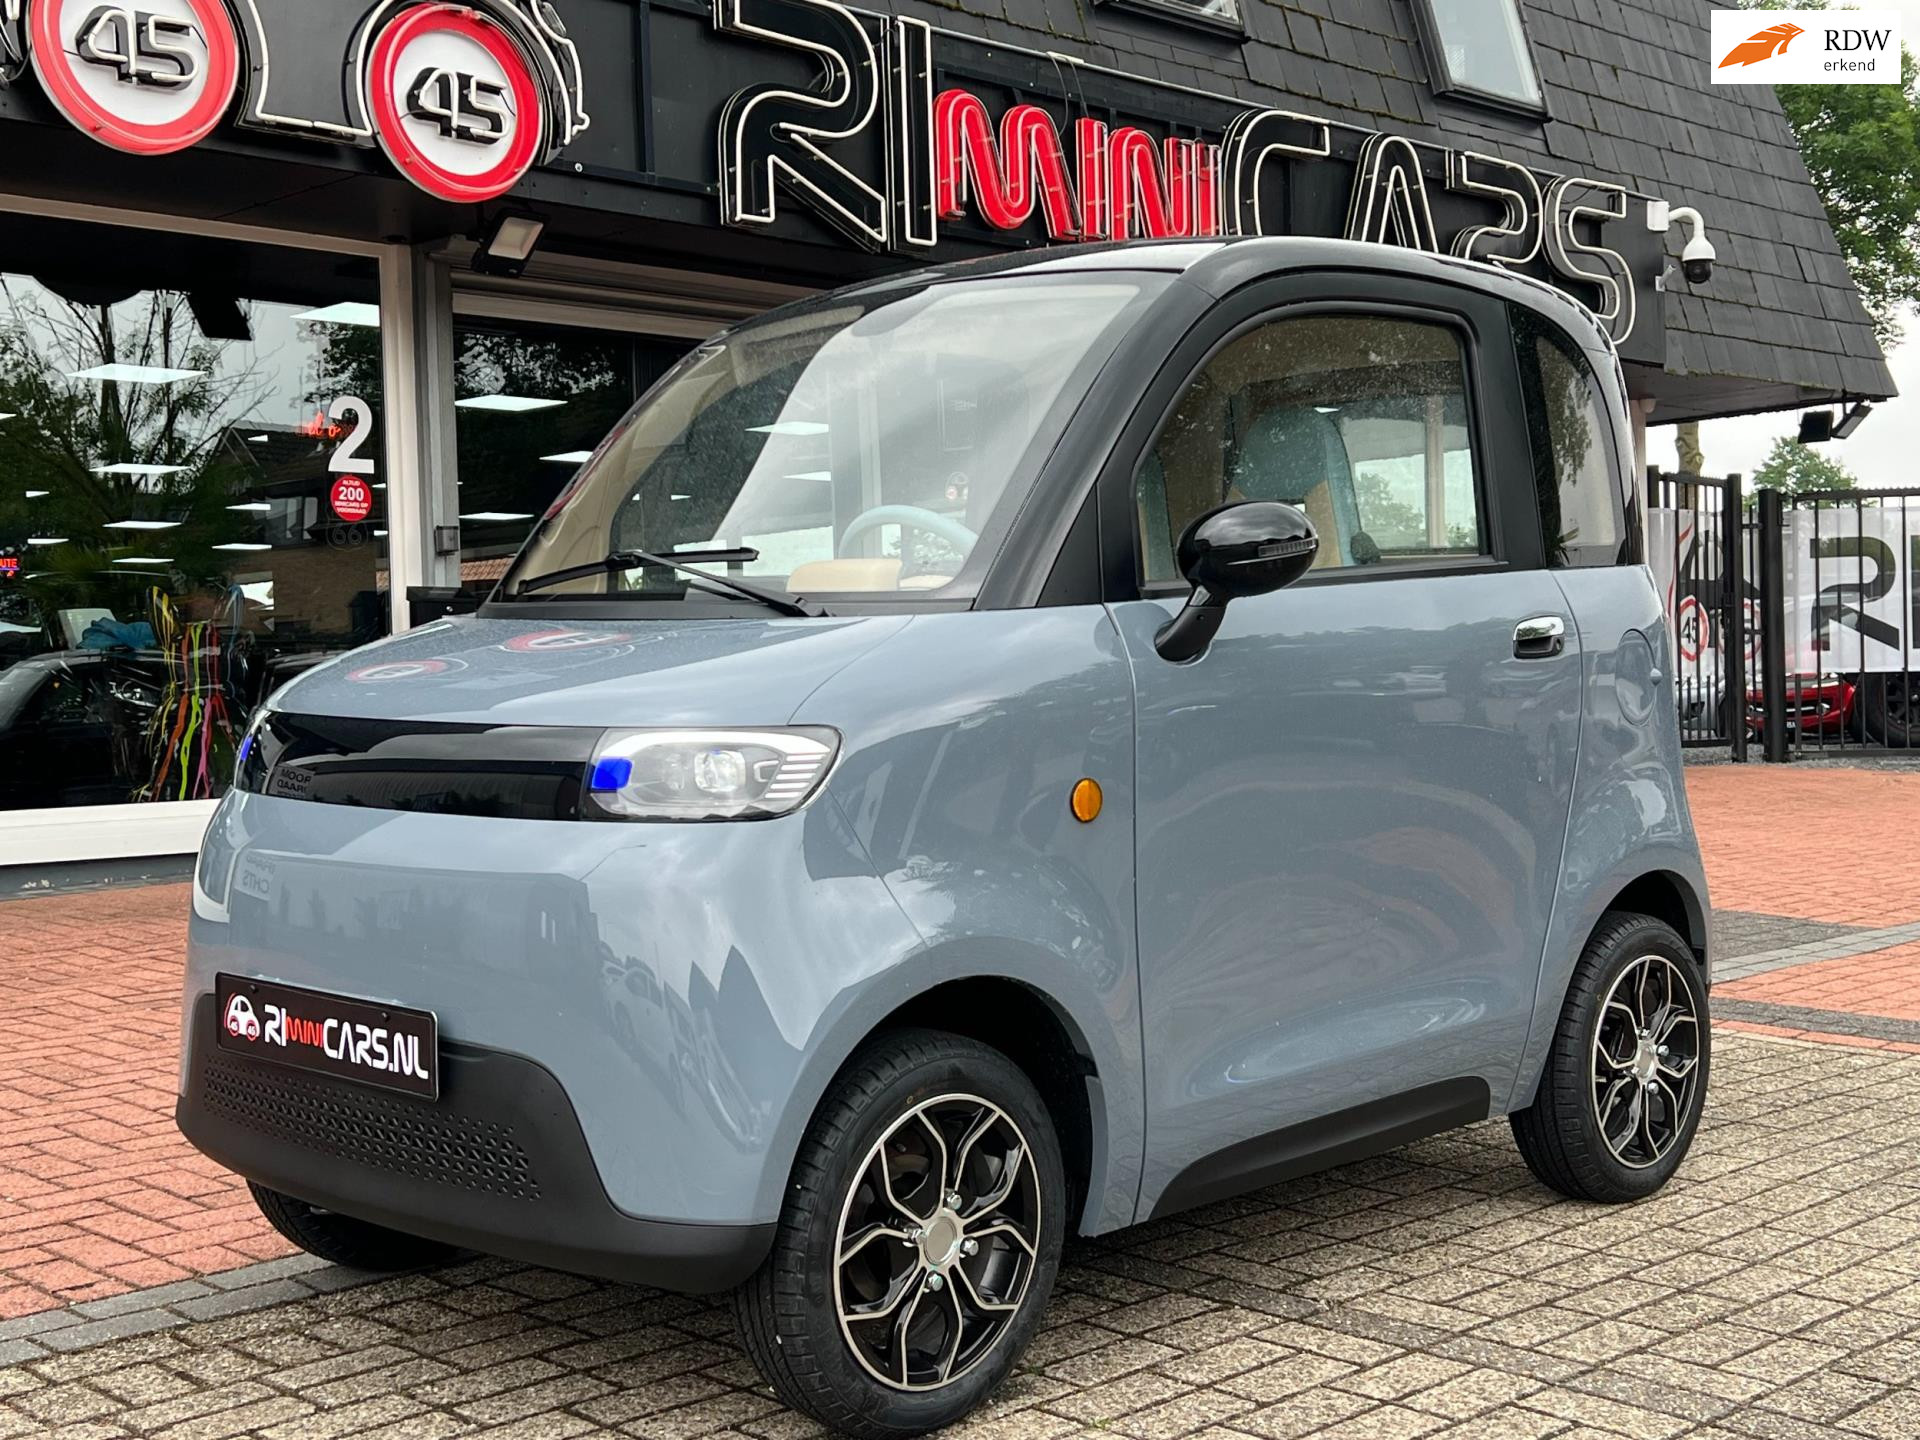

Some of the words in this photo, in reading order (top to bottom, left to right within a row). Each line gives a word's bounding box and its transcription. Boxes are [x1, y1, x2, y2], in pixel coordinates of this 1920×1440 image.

[75, 8, 199, 89] 45
[406, 66, 513, 146] 45
[328, 395, 375, 474] 2
[338, 486, 365, 502] 200
